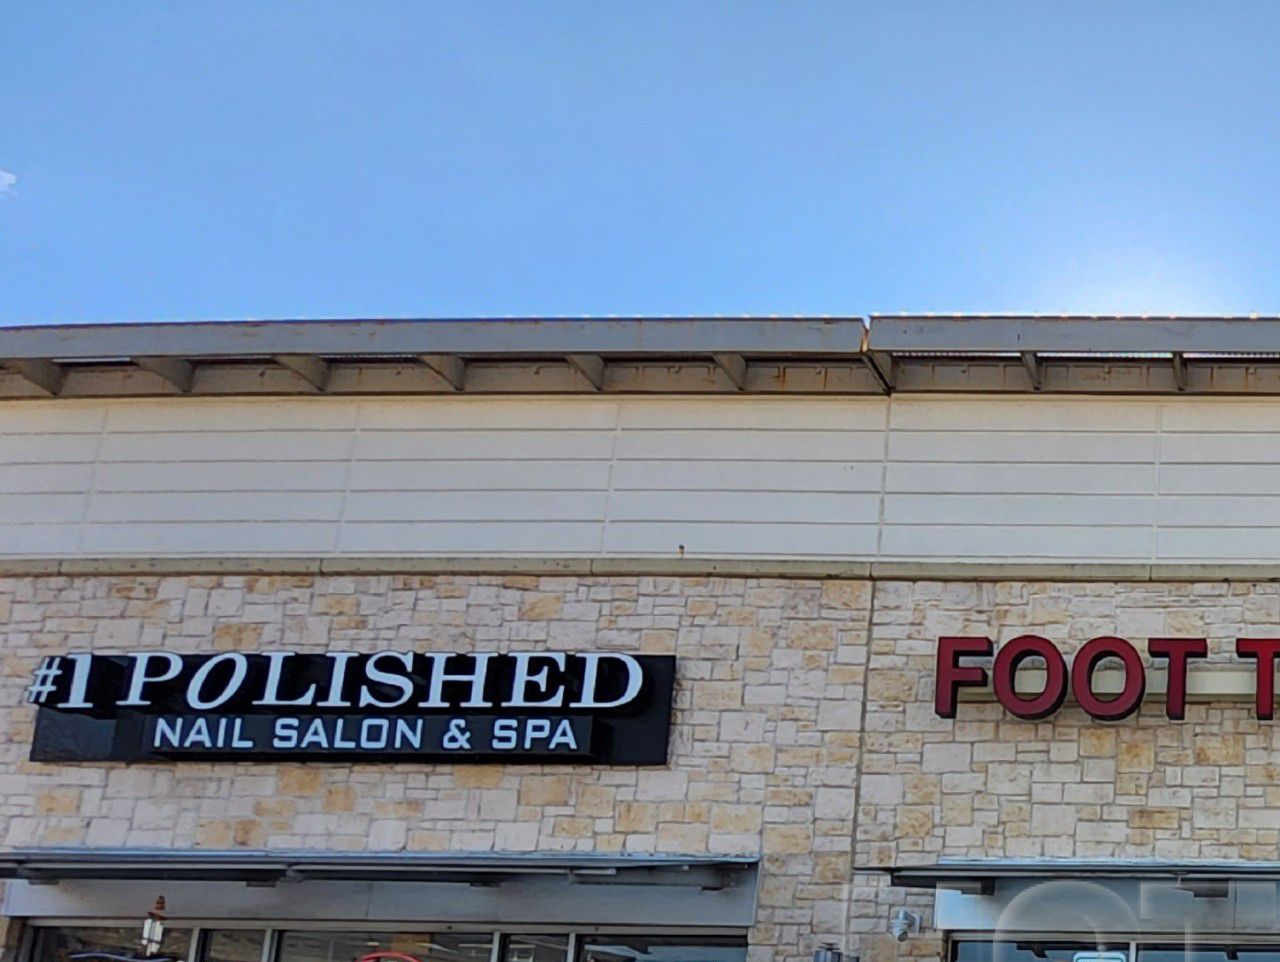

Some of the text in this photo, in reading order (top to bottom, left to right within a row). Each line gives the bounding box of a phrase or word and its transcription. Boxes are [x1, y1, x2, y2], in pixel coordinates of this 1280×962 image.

[26, 651, 645, 710] #1 POLISHED
[933, 635, 1208, 722] FOOT
[153, 716, 578, 750] NAIL SALON & SPA
